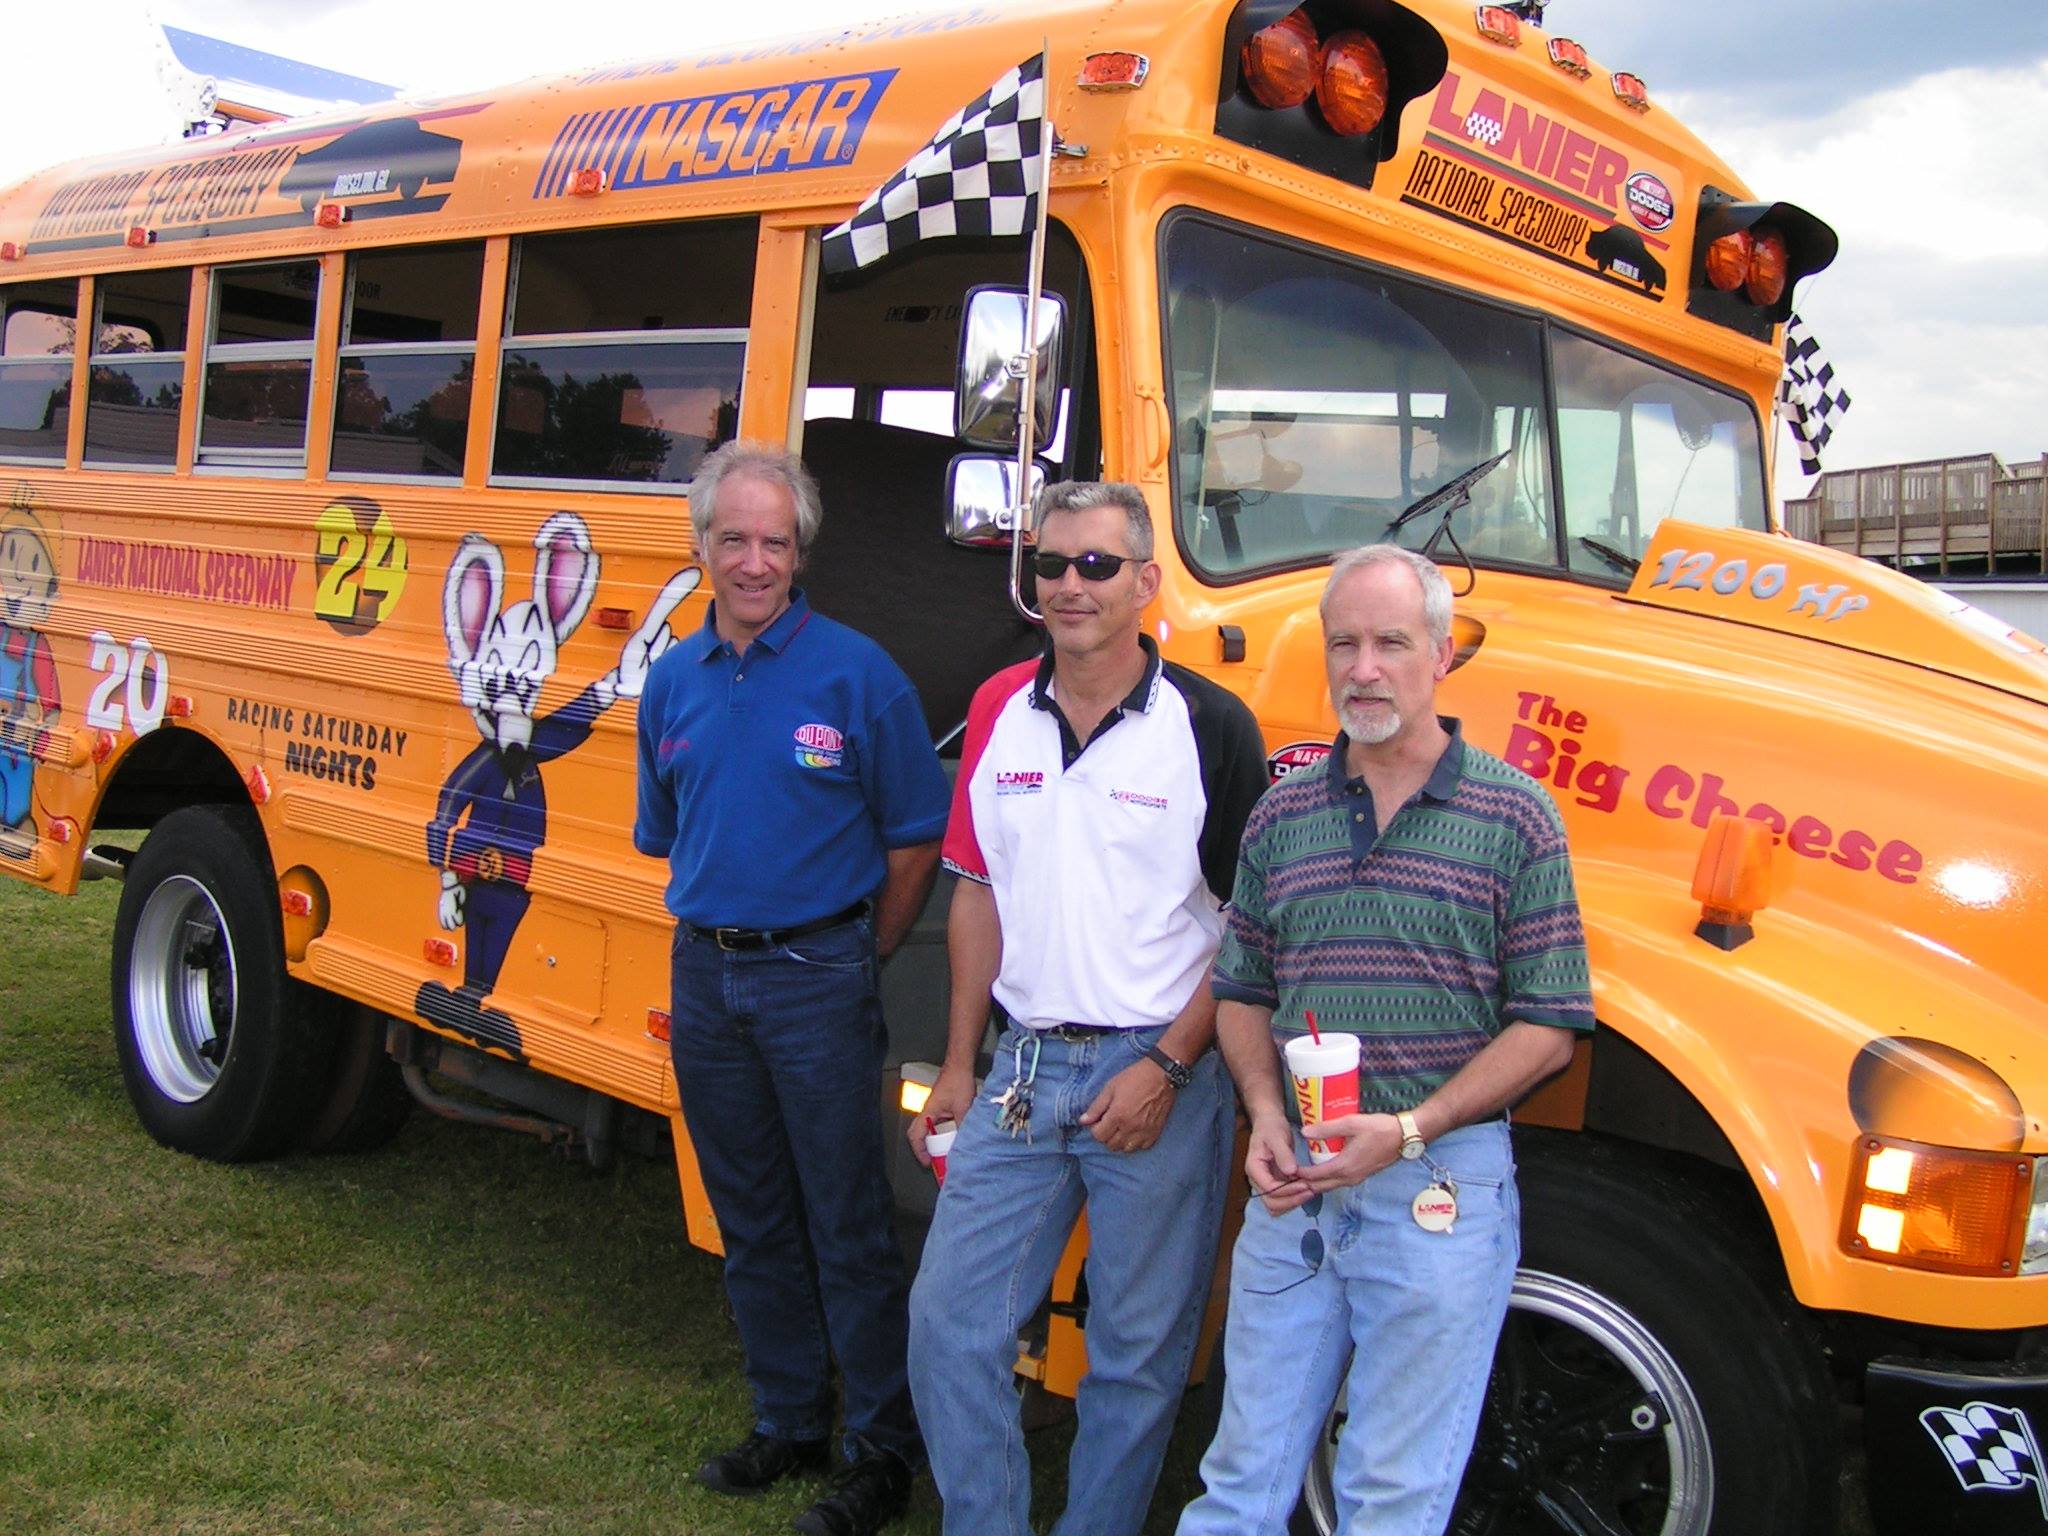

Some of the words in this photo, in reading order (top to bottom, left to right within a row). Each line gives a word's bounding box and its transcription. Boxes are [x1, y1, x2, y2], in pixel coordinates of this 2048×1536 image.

[623, 78, 872, 184] NASCAR
[1428, 71, 1629, 209] LANIER
[30, 169, 152, 238] NATIONAL
[132, 146, 301, 226] SPEEDWAY
[1405, 150, 1496, 223] NATIONAL
[1492, 187, 1589, 257] SPEEDWAY
[1629, 187, 1670, 217] DODGE
[77, 536, 126, 588] LANIER
[128, 541, 201, 599] NATIONAL
[203, 549, 298, 611] SPEEDWAY
[313, 503, 408, 623] 24
[1649, 548, 1787, 599] 1200
[1788, 582, 1869, 622] HP
[87, 631, 168, 736] 20
[1517, 691, 1588, 734] The
[227, 697, 294, 733] RACING
[302, 711, 408, 757] SATURDAY
[284, 740, 377, 791] NIGHTS
[798, 727, 815, 744] DU
[997, 772, 1043, 783] LANIER
[1503, 723, 1630, 814] Big
[1645, 764, 1923, 884] Cheese
[1294, 1074, 1322, 1154] SNIC
